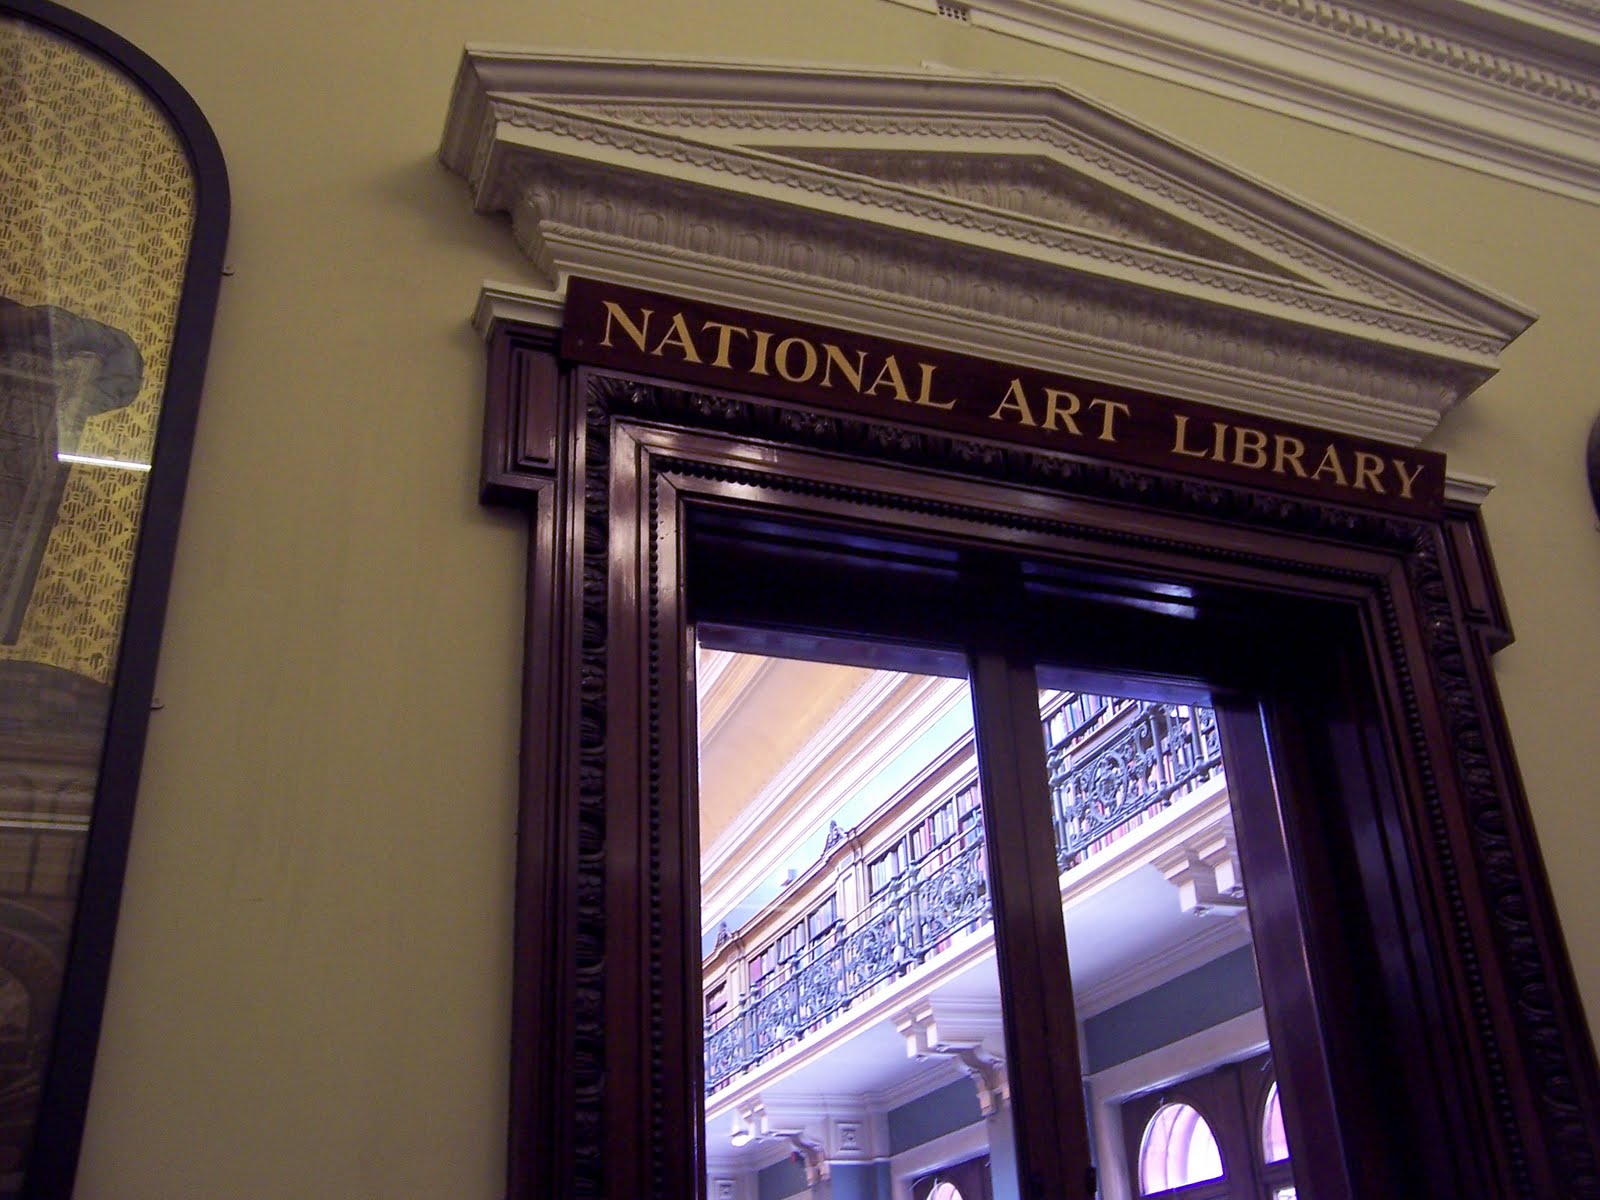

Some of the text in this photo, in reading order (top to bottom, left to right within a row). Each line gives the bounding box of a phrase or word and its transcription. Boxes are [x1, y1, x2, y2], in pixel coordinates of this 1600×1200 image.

[600, 301, 1425, 499] NATIONAL ART LIBRARY
